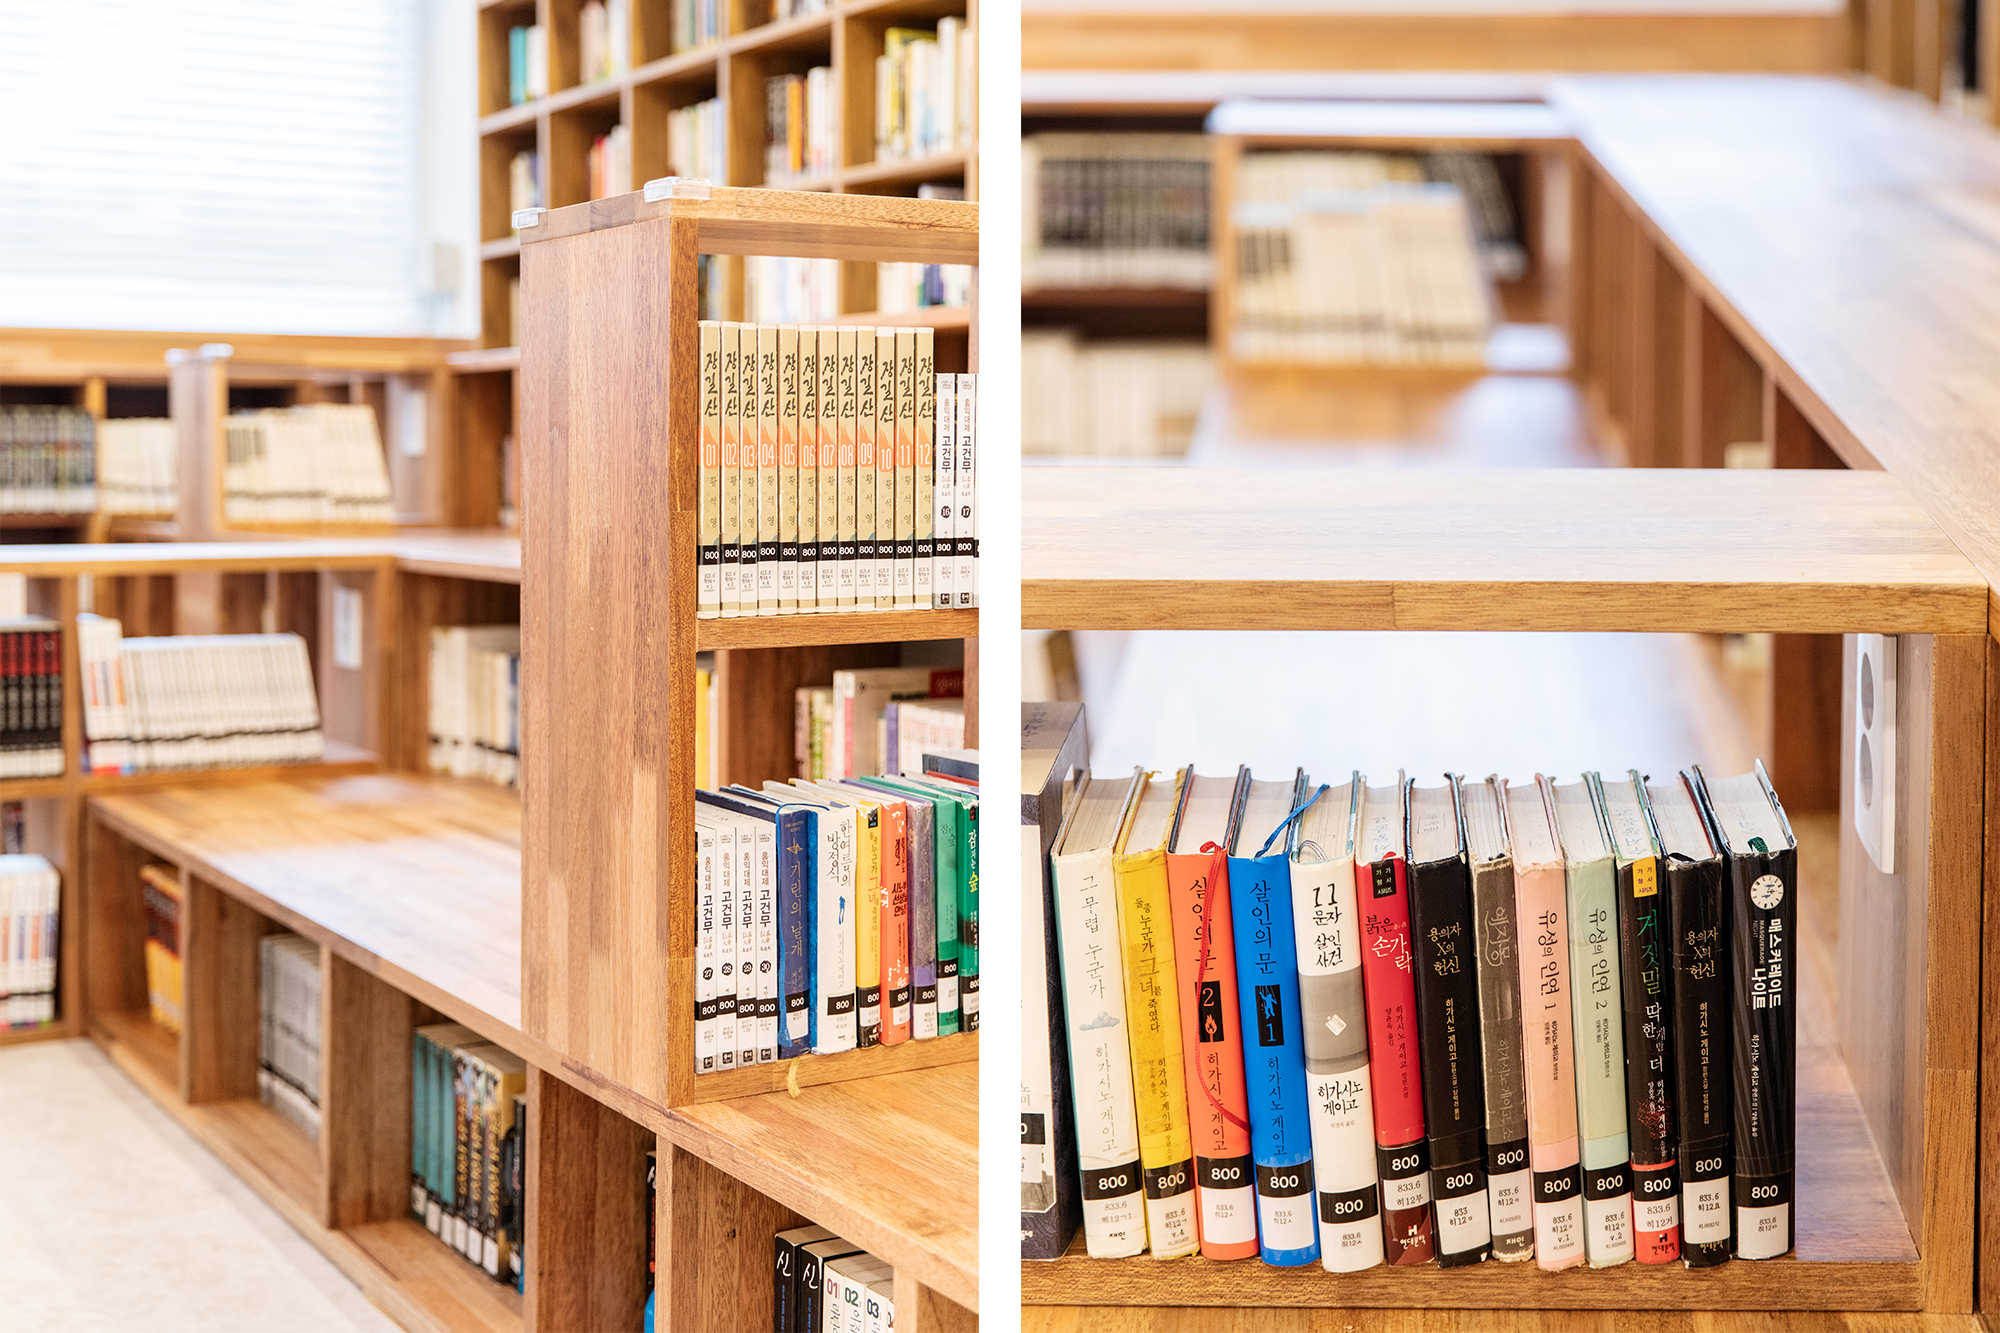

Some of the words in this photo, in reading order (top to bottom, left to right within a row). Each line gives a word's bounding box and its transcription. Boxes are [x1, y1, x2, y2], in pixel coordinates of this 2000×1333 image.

[704, 351, 718, 417] 장길산
[725, 351, 737, 417] 장길산
[742, 353, 755, 418] 장길산
[880, 360, 894, 423] 장길산
[899, 356, 912, 419] 장길산
[918, 356, 932, 419] 장길산
[706, 443, 715, 466] 01
[726, 443, 737, 466] 02
[744, 445, 755, 467] 03
[762, 443, 774, 466] 04
[784, 443, 795, 466] 05
[803, 445, 815, 467] 06
[823, 444, 834, 466] 07
[841, 444, 854, 466] 08
[860, 443, 873, 465] 09
[881, 448, 892, 470] 10
[900, 445, 910, 466] 11
[920, 443, 931, 465] 12
[942, 436, 952, 473] 고건무
[962, 436, 972, 473] 고건무
[705, 551, 719, 560] 800
[741, 550, 757, 559] 800
[782, 547, 797, 556] 800
[822, 546, 837, 555] 800
[859, 545, 874, 554] 800
[897, 545, 912, 554] 800
[937, 543, 951, 552] 800
[826, 831, 840, 883] 방정식
[840, 819, 852, 887] 한여름의
[790, 861, 802, 917] 기린의
[1312, 883, 1338, 908] 11
[703, 895, 713, 934] 고건무
[721, 891, 732, 930] 고건무
[742, 890, 752, 929] 고건무
[760, 889, 771, 928] 고건무
[1249, 879, 1272, 949] 살인의
[1312, 906, 1342, 926] 문자
[1364, 914, 1394, 935] 붉은
[1428, 922, 1461, 942] 용의자
[1538, 910, 1558, 957] 유성의
[1588, 908, 1608, 955] 유성의
[791, 921, 803, 957] 날개
[1314, 930, 1342, 950] 살인
[1685, 926, 1718, 946] 용의자
[1316, 947, 1343, 968] 사건
[1436, 941, 1454, 956] X의
[1636, 908, 1661, 995] 거짓말
[1693, 945, 1711, 960] X의
[944, 963, 956, 973] 800
[1085, 944, 1105, 999] 누군가
[1140, 915, 1154, 953] 누군가
[1147, 998, 1160, 1033] 죽였다
[1254, 953, 1277, 974] 문
[1433, 956, 1460, 976] 헌신
[1690, 960, 1716, 980] 헌신
[1768, 918, 1782, 1009] 매스커레이드
[1540, 961, 1560, 996] 인연
[1591, 959, 1610, 994] 인연
[898, 992, 908, 1002] 800
[1202, 987, 1215, 1007] 2
[1752, 968, 1767, 1010] 나이트
[719, 1000, 735, 1010] 800
[740, 1003, 754, 1013] 800
[791, 997, 804, 1007] 800
[1544, 1002, 1556, 1010] 1
[1595, 1000, 1608, 1010] 2
[1645, 1001, 1662, 1022] 딱
[1396, 1005, 1406, 1040] 히가시노
[1445, 998, 1456, 1033] 히가시노
[1699, 1001, 1708, 1037] 히가시노
[1266, 1024, 1277, 1042] 1
[1399, 1042, 1408, 1068] 게이고
[1447, 1034, 1457, 1061] 게이고
[1700, 1038, 1709, 1065] 게이고
[1751, 1034, 1760, 1063] 히가시노
[1095, 1043, 1113, 1102] 히가시노
[1650, 1055, 1663, 1072] 더
[1158, 1057, 1169, 1098] 히가시노
[1267, 1056, 1284, 1111] 히가시노
[1751, 1064, 1760, 1086] 게이고
[1317, 1080, 1364, 1100] 히가시노
[1656, 1079, 1666, 1113] 히가시노
[1161, 1101, 1172, 1132] 게이고
[1323, 1098, 1359, 1116] 게이고
[1101, 1106, 1117, 1152] 게이고
[1211, 1112, 1227, 1151] 게이고
[1271, 1115, 1287, 1156] 게이고
[1658, 1113, 1666, 1139] 게이고
[1392, 1154, 1419, 1171] 800
[1497, 1149, 1524, 1166] 800
[1695, 1157, 1722, 1173] 800
[1098, 1174, 1128, 1190] 800
[1158, 1172, 1185, 1189] 800
[1211, 1167, 1240, 1180] 800
[1270, 1175, 1299, 1189] 800
[1446, 1172, 1473, 1189] 800
[1597, 1174, 1623, 1191] 800
[1397, 1181, 1420, 1192] 833.6
[1498, 1186, 1519, 1197] 833.6
[1544, 1177, 1571, 1194] 800
[1644, 1177, 1671, 1193] 800
[1751, 1184, 1778, 1199] 800
[1104, 1201, 1127, 1211] 833.6
[1334, 1199, 1364, 1215] 800
[1699, 1192, 1720, 1202] 833.6
[1165, 1208, 1186, 1220] 833.6
[1454, 1207, 1468, 1217] 833
[1552, 1213, 1572, 1224] 833.6
[1605, 1212, 1624, 1222] 833.6
[1647, 1204, 1670, 1214] 833.6
[1759, 1217, 1776, 1225] 833.6
[1172, 1229, 1184, 1238] v.4
[1342, 1232, 1361, 1241] 833.6
[1506, 1236, 1524, 1247] 재인
[1557, 1234, 1570, 1243] v.1
[1610, 1232, 1622, 1241] v.2
[776, 1251, 791, 1277] 신
[802, 1263, 818, 1289] 신
[826, 1278, 839, 1299] 01
[845, 1287, 859, 1307] 02
[867, 1298, 879, 1319] 03
